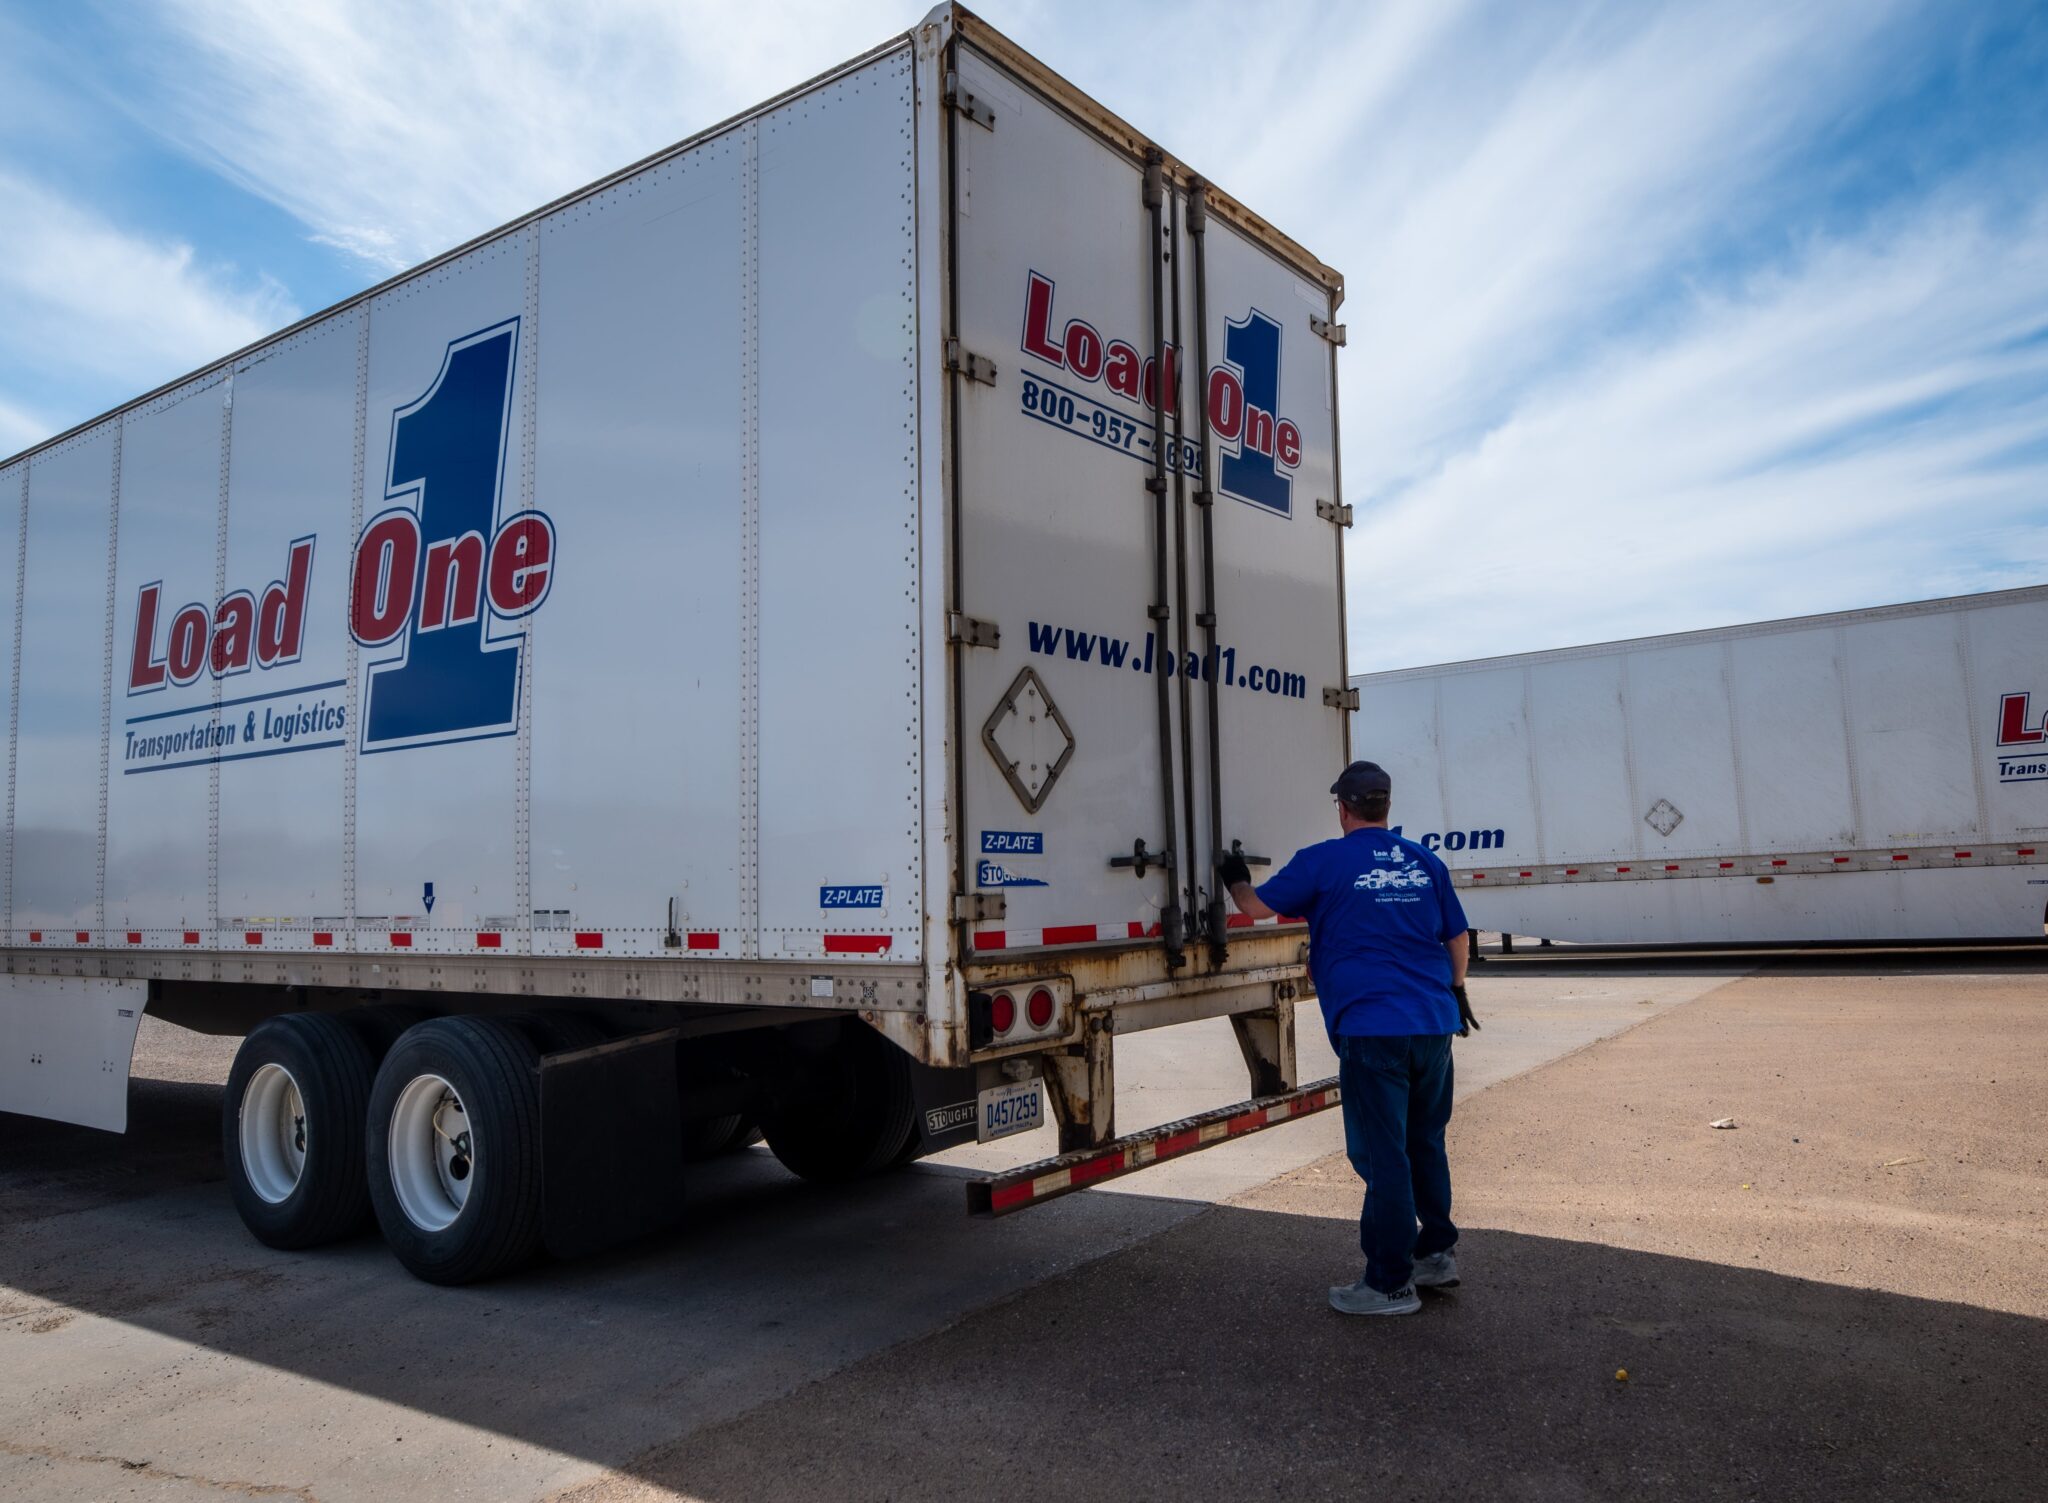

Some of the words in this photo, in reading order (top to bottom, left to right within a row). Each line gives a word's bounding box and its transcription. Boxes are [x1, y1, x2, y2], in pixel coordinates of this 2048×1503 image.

[1021, 269, 1182, 419] Load
[1206, 365, 1302, 469] One
[127, 534, 317, 697] Load
[348, 507, 556, 648] One
[125, 720, 236, 761] Transportation
[243, 710, 256, 743] &
[263, 700, 346, 743] Logistics
[1996, 692, 2048, 747] L
[1999, 762, 2048, 777] Trans
[985, 834, 1035, 850] Z-PLATE
[824, 889, 882, 904] Z-PLATE
[928, 1105, 978, 1130] STOUGHT
[986, 1092, 1038, 1129] D457259
[1387, 1287, 1413, 1301] HOKA
